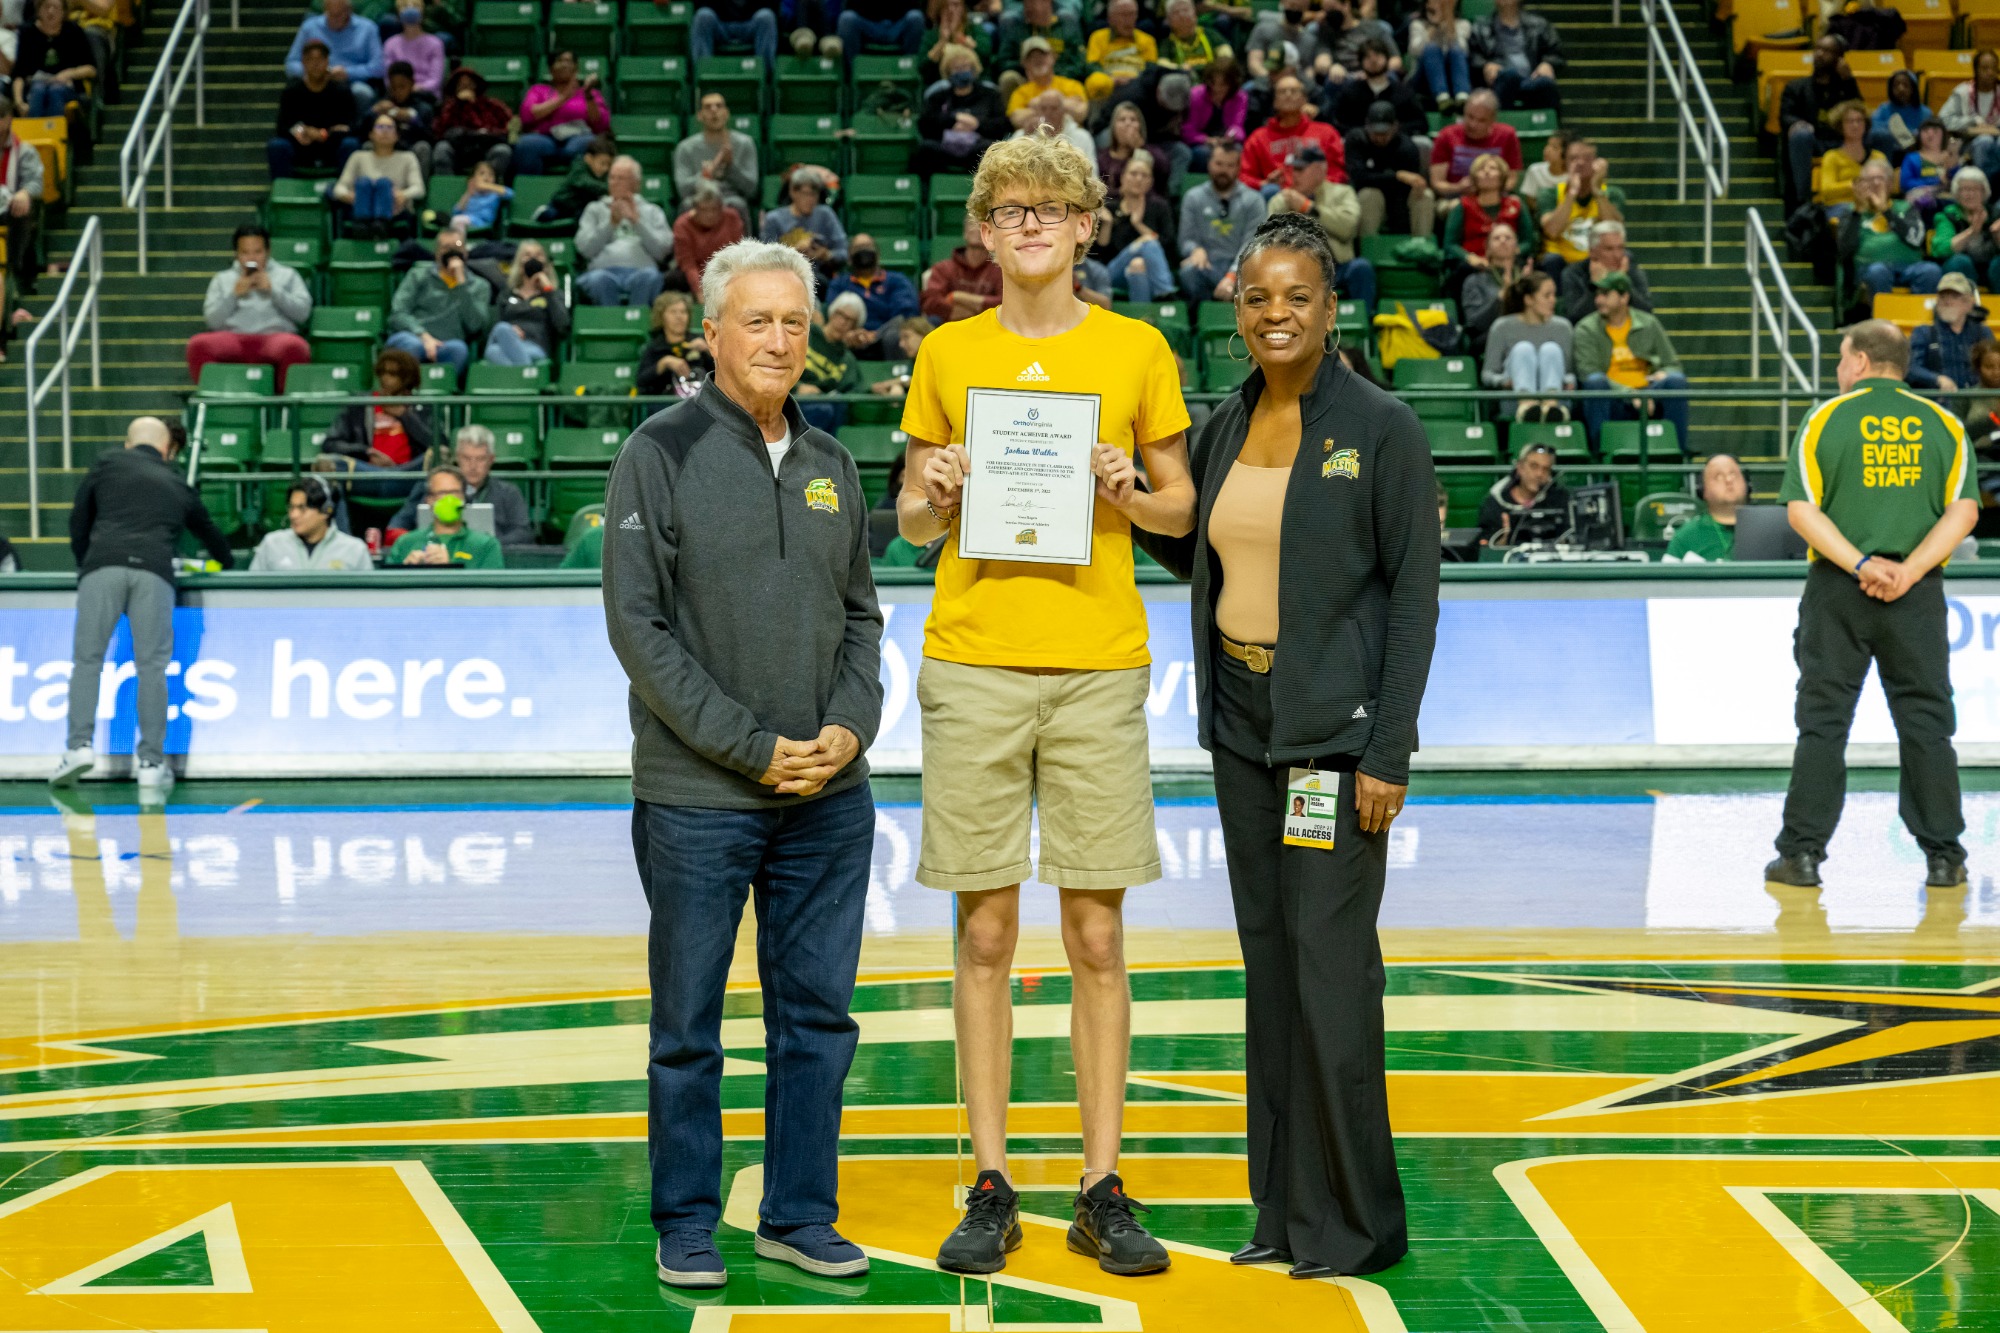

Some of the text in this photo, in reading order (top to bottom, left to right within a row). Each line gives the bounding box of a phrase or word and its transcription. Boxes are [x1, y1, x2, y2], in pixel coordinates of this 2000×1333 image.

[1016, 373, 1050, 382] adidas
[1012, 420, 1053, 428] OrthoVirginia
[1860, 415, 1923, 442] CSC
[1004, 446, 1058, 457] Joshua Walker
[1862, 443, 1923, 465] EVENT
[1322, 460, 1360, 479] MASON
[1862, 466, 1923, 488] STAFF
[270, 638, 534, 721] here.
[1286, 826, 1332, 840] ALL ACCESS
